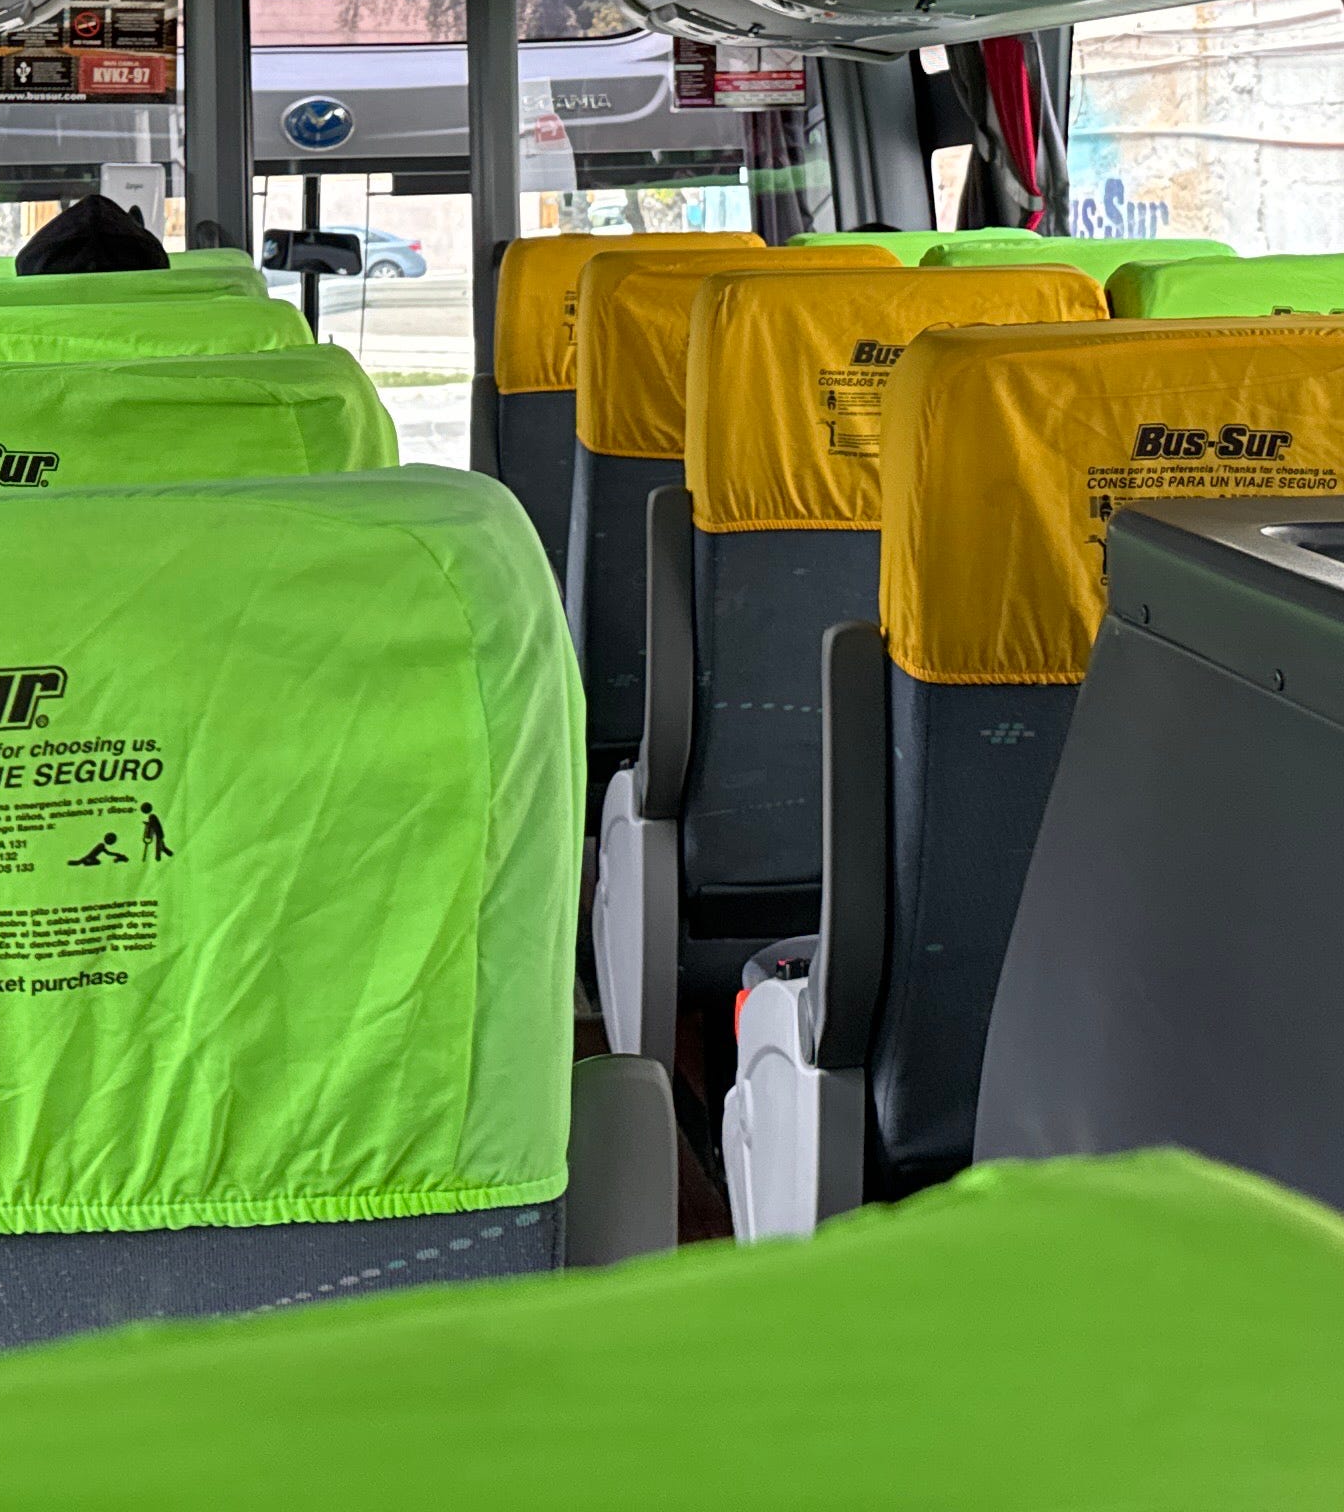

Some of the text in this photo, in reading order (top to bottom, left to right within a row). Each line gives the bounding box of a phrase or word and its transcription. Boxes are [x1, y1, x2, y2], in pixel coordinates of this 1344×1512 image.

[93, 67, 151, 84] KVKZ-97
[1069, 178, 1170, 239] us-Sur
[1131, 423, 1293, 461] Bus-Sur
[1088, 466, 1126, 476] Gracias
[1127, 467, 1144, 476] por
[1146, 467, 1158, 475] su
[1160, 464, 1214, 474] preferencia
[1222, 465, 1257, 475] Thanks
[1276, 466, 1319, 477] choosing
[1322, 468, 1336, 476] us.
[1087, 476, 1338, 489] CONSEJOS PARA UN VIAJE SEGURO
[29, 736, 126, 756] choosing
[132, 738, 161, 754] us.
[33, 758, 163, 787] SEGURO
[9, 840, 27, 850] 131
[0, 852, 18, 862] 132
[15, 863, 34, 873] 133
[31, 970, 128, 996] purchase
